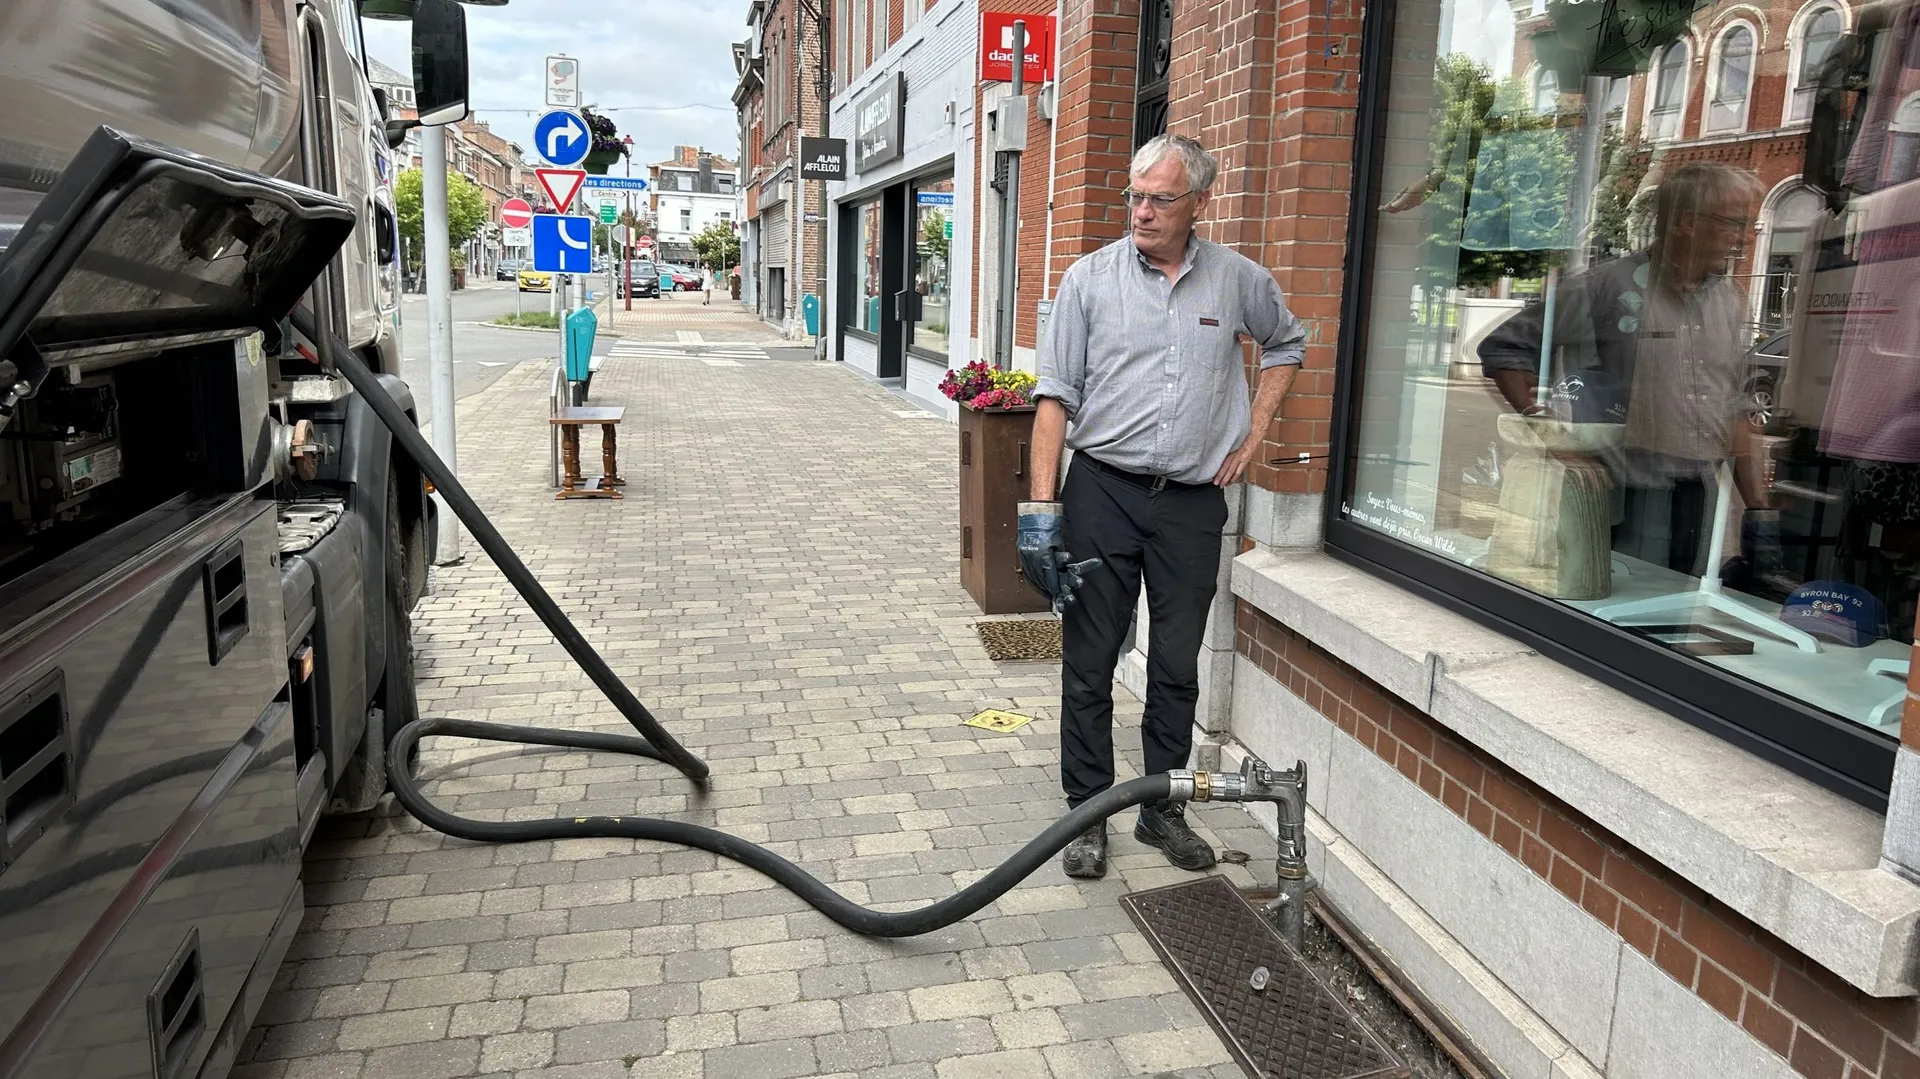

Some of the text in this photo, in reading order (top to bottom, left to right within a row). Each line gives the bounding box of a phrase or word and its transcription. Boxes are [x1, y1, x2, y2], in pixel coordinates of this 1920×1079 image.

[989, 49, 1040, 63] daost
[816, 154, 840, 164] ALAIN
[803, 162, 840, 173] AFFLELOU
[600, 179, 642, 188] directions
[1366, 491, 1385, 509] Soyez
[1351, 508, 1369, 521] autres
[1369, 516, 1382, 526] sont
[1383, 517, 1397, 534] déjà
[1413, 528, 1433, 546] Oscar
[1434, 535, 1456, 554] Wilde
[1800, 590, 1863, 608] BYRON BAY 92
